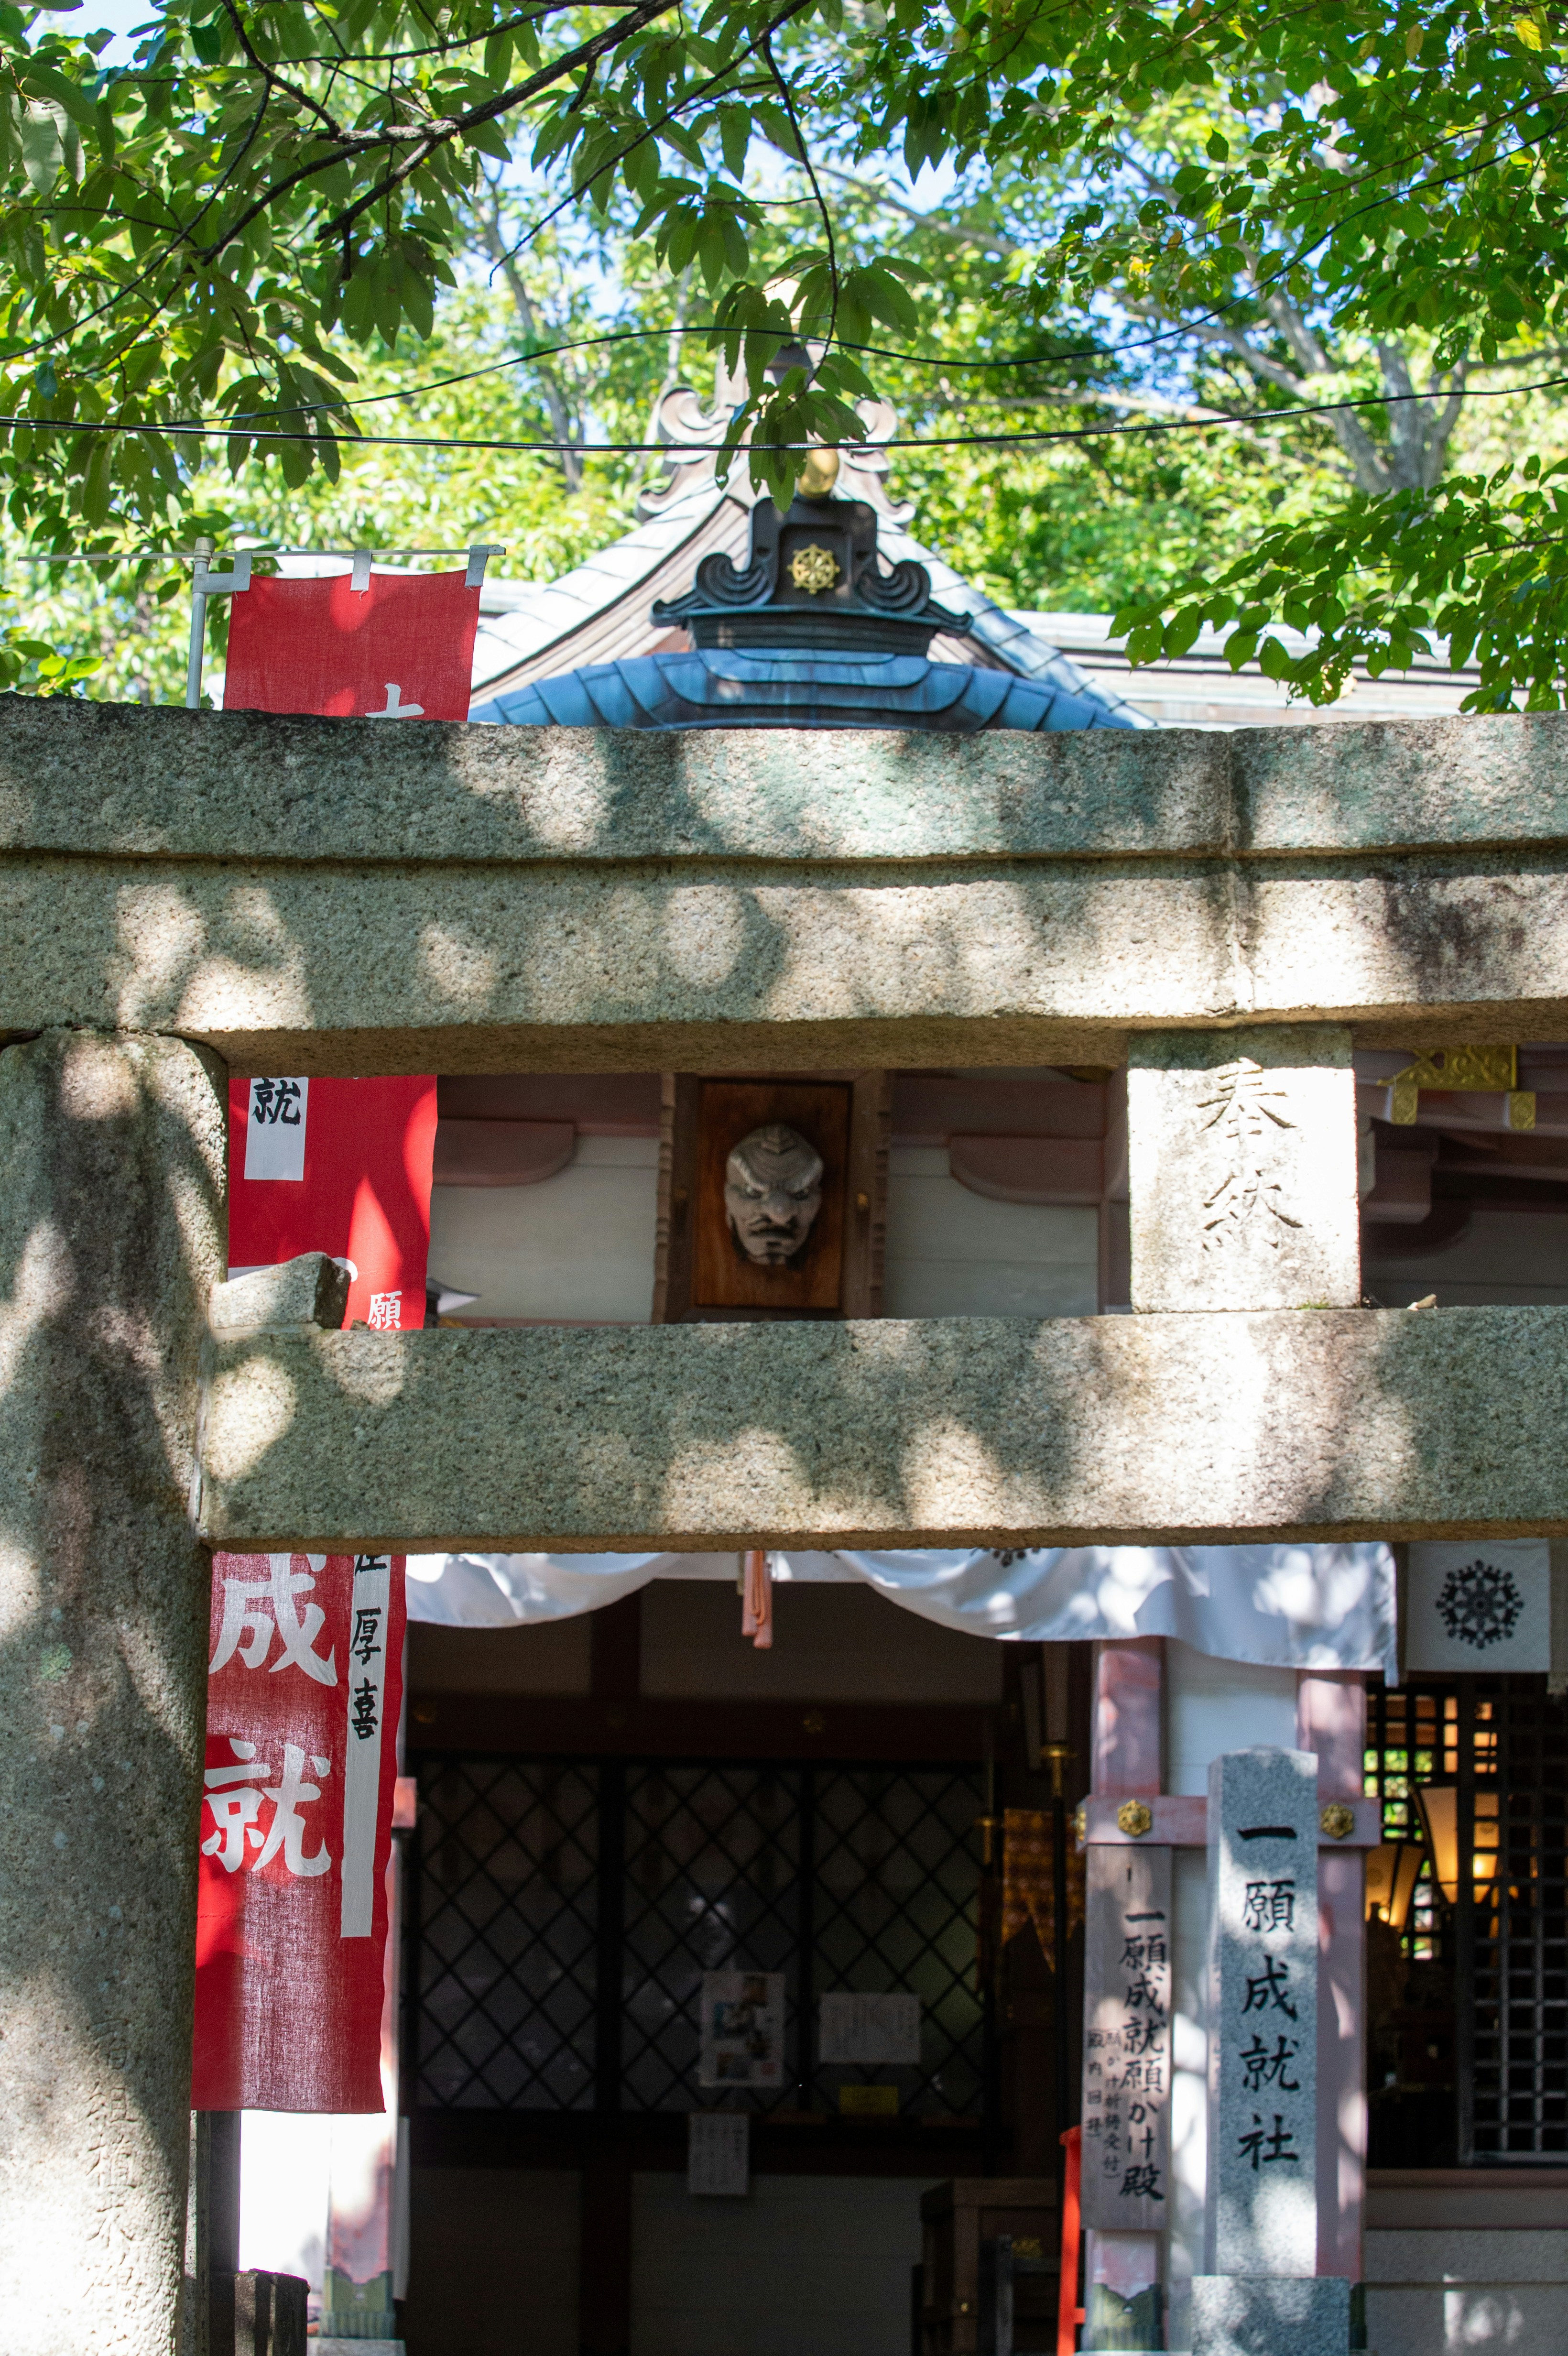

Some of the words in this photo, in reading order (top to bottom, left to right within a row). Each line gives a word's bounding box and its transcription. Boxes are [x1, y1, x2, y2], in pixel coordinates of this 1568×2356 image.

[252, 1078, 301, 1126] 就
[367, 1290, 403, 1330] 願
[1118, 1910, 1166, 2201] 一願成就願かけ殿
[1236, 1825, 1301, 2171] 一願成就社
